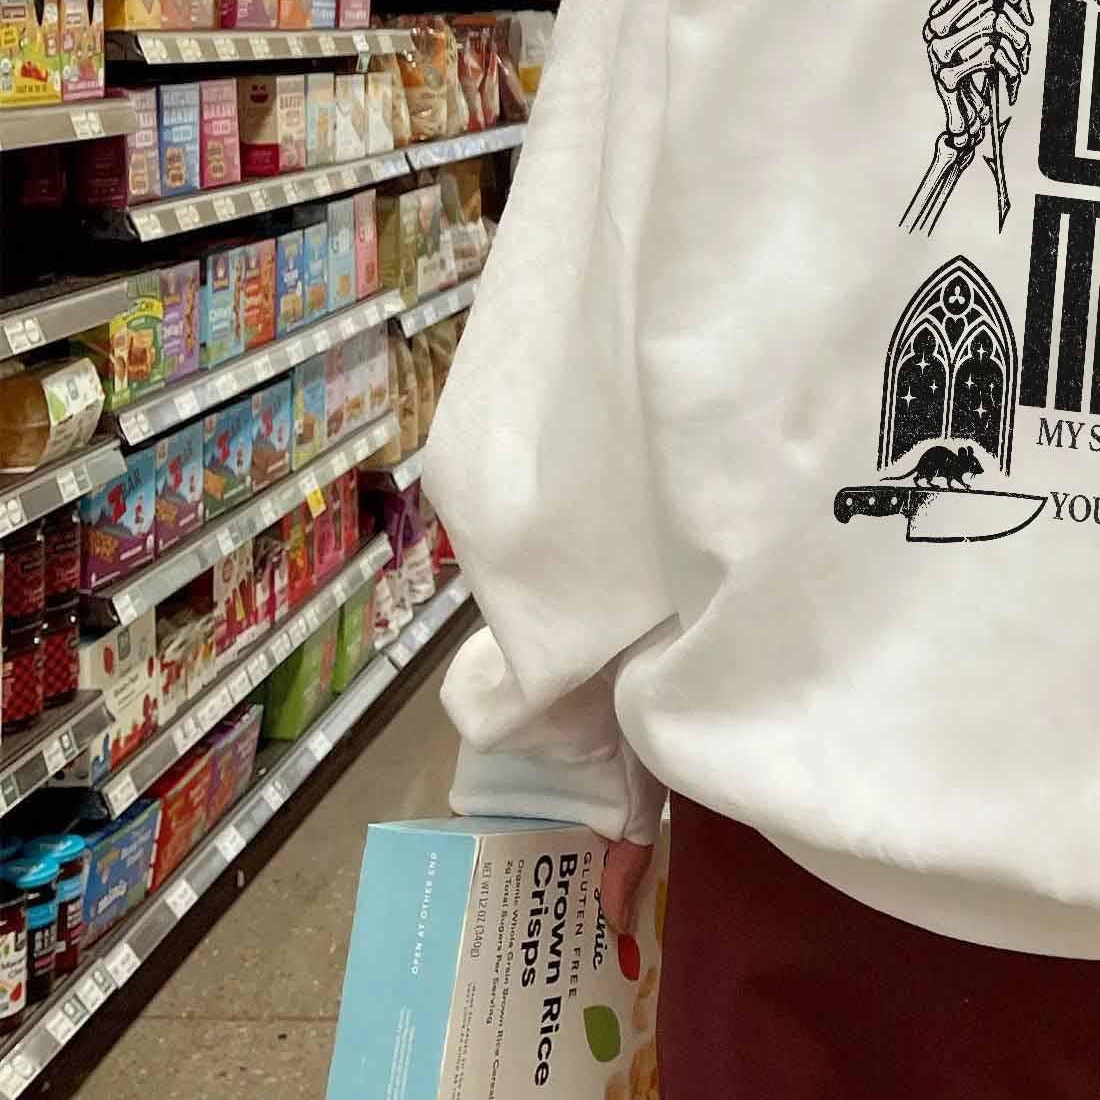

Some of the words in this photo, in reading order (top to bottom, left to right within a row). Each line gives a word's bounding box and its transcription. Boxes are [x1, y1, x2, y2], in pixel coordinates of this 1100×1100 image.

[1036, 417, 1086, 450] MY
[427, 850, 439, 877] END
[481, 861, 493, 878] NET
[418, 879, 435, 920] OTHER
[479, 881, 490, 895] WT
[574, 851, 592, 936] GLUTEN
[415, 923, 426, 939] AT
[520, 854, 554, 988] Crisps
[545, 852, 579, 985] Brown
[409, 941, 425, 976] OPEN
[568, 946, 582, 999] FREE
[534, 995, 563, 1087] Rice
